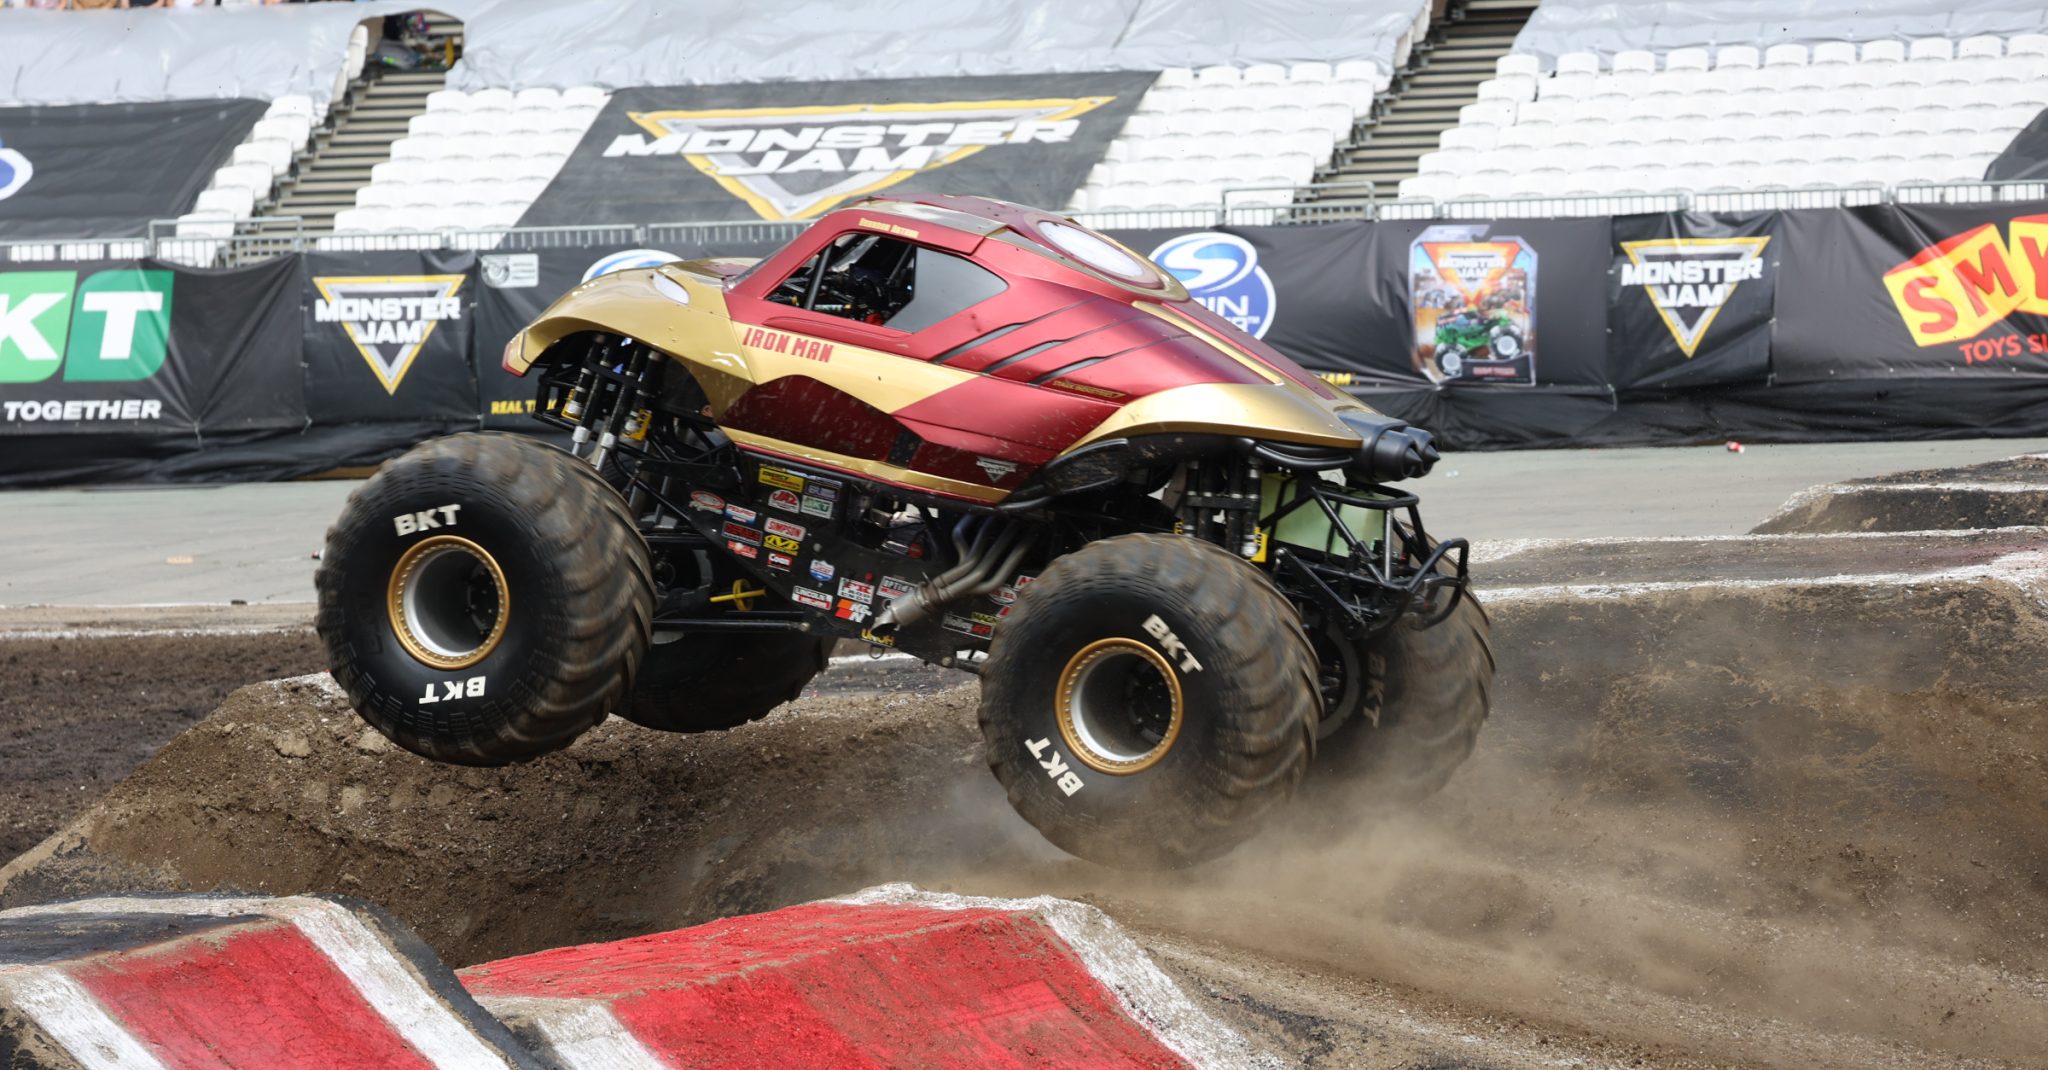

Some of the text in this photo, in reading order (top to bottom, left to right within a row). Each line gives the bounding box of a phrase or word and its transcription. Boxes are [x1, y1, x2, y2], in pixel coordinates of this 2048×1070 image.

[603, 118, 1081, 158] MONSTER
[715, 146, 930, 175] JAM
[1620, 256, 1763, 287] MONSTER
[315, 296, 461, 322] MONSTER
[1659, 283, 1724, 308] JAM
[358, 320, 422, 344] JAM
[742, 327, 834, 363] IRON MAN
[1959, 334, 2022, 365] TOYS
[4, 399, 162, 421] TOGETHER
[491, 400, 524, 414] REAL
[393, 503, 461, 537] BKT
[767, 520, 801, 537] SIMPSON
[1142, 614, 1203, 674] BKT
[419, 675, 487, 704] BKT
[1025, 737, 1085, 798] BKT
